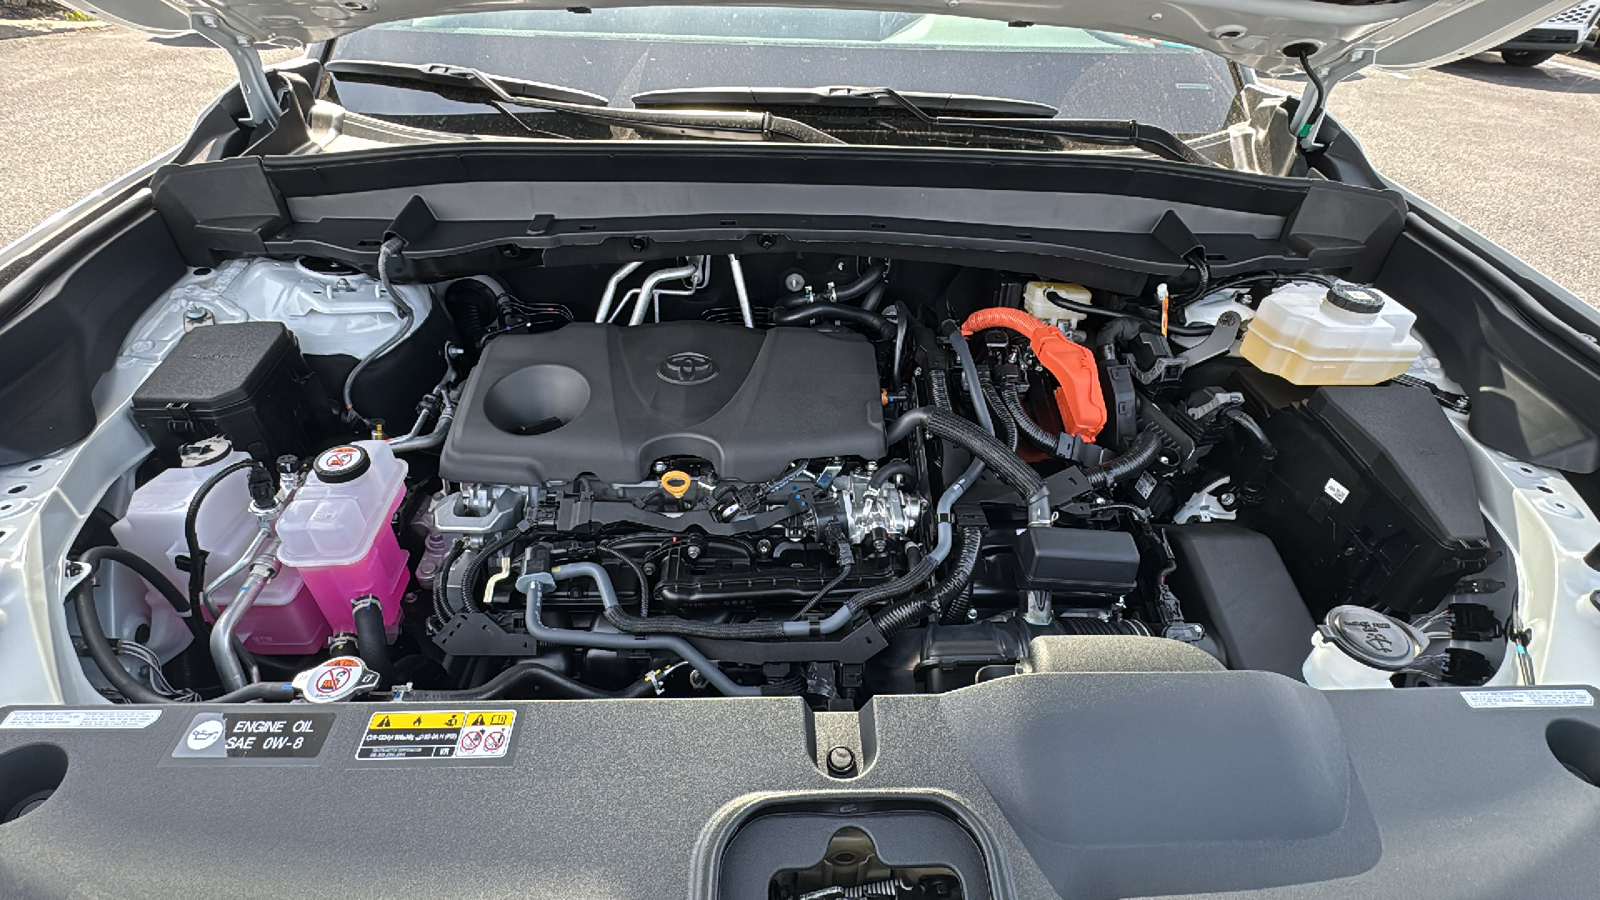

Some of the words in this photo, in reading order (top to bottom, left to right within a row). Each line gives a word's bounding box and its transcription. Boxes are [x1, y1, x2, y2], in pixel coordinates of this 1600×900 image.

[233, 720, 287, 733] ENGINE
[292, 720, 314, 733] OIL
[225, 736, 257, 749] SAE
[262, 736, 304, 749] 0W-8
